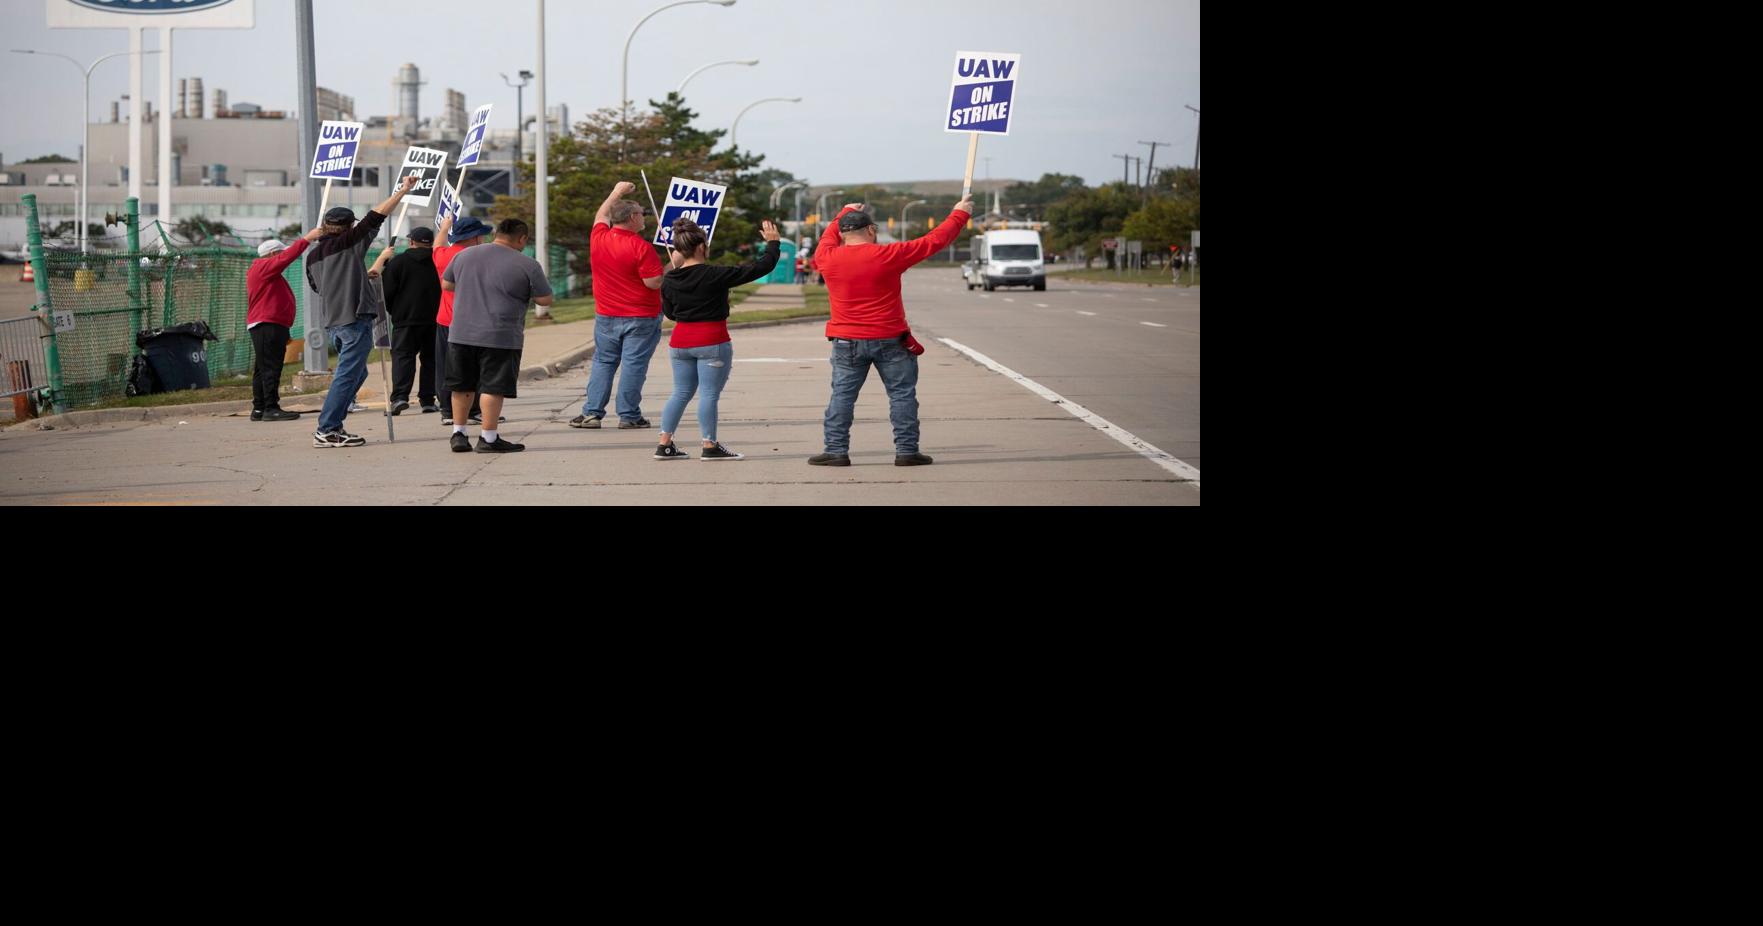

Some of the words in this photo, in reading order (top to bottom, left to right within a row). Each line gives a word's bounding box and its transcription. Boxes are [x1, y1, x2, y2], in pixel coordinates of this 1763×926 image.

[958, 58, 1015, 78] UAW
[970, 85, 994, 105] ON
[951, 101, 1008, 127] STRIKE
[322, 126, 360, 140] UAW
[328, 144, 345, 159] ON
[408, 150, 443, 166] UAW
[314, 156, 353, 174] STRIKE
[672, 184, 721, 206] UAW
